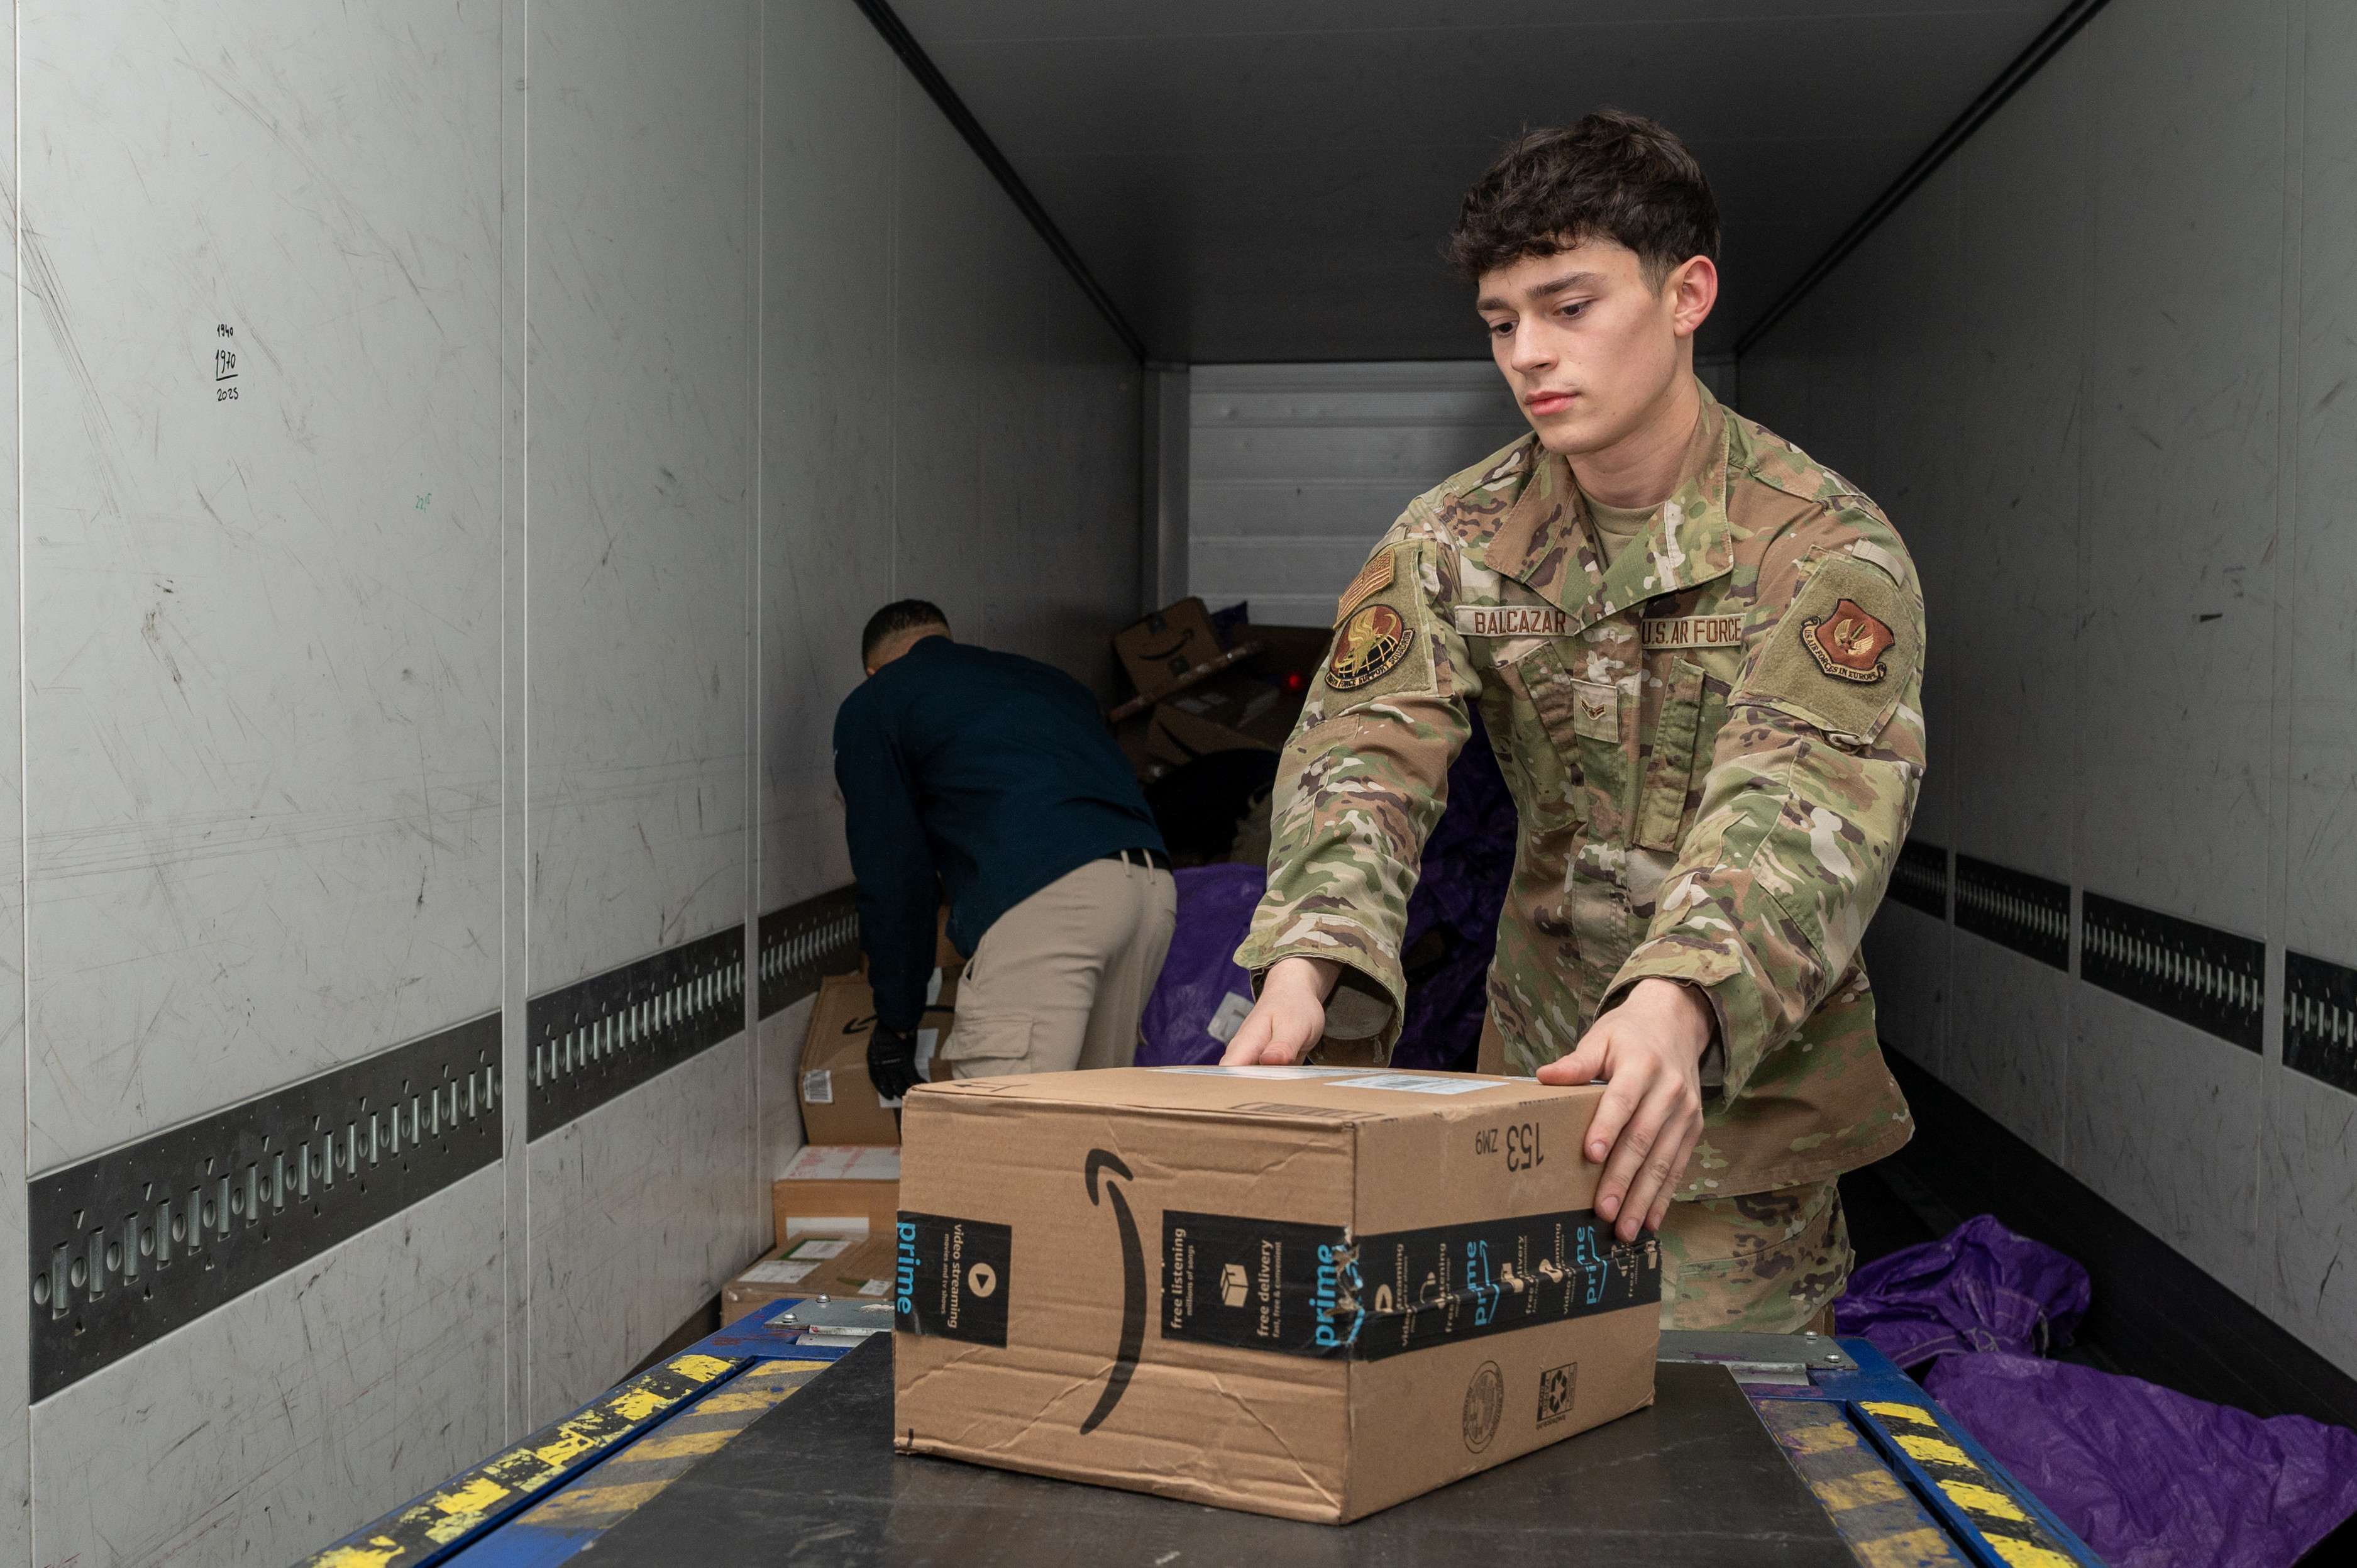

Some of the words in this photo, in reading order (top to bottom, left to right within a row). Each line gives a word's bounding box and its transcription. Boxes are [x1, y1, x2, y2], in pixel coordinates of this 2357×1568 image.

[217, 323, 234, 338] 1940
[215, 349, 236, 378] 1970
[1474, 610, 1566, 634] BALCAZAR
[1642, 621, 1669, 644] U.S.
[1694, 617, 1741, 643] FORCE
[1807, 639, 1819, 652] AIR
[1816, 650, 1839, 673] FORCES
[1838, 668, 1847, 676] IN
[1339, 679, 1356, 687] FORCE
[1507, 1122, 1544, 1172] 153
[954, 1224, 964, 1259] video
[897, 1222, 921, 1314] prime
[1171, 1228, 1187, 1294] listening
[1186, 1270, 1193, 1280] of
[1258, 1239, 1274, 1301] delivery
[947, 1262, 961, 1328] streaming
[1309, 1244, 1340, 1347] prime
[1467, 1241, 1487, 1326] prime
[1171, 1298, 1183, 1328] free
[1257, 1306, 1270, 1337] free
[1272, 1300, 1281, 1317] free
